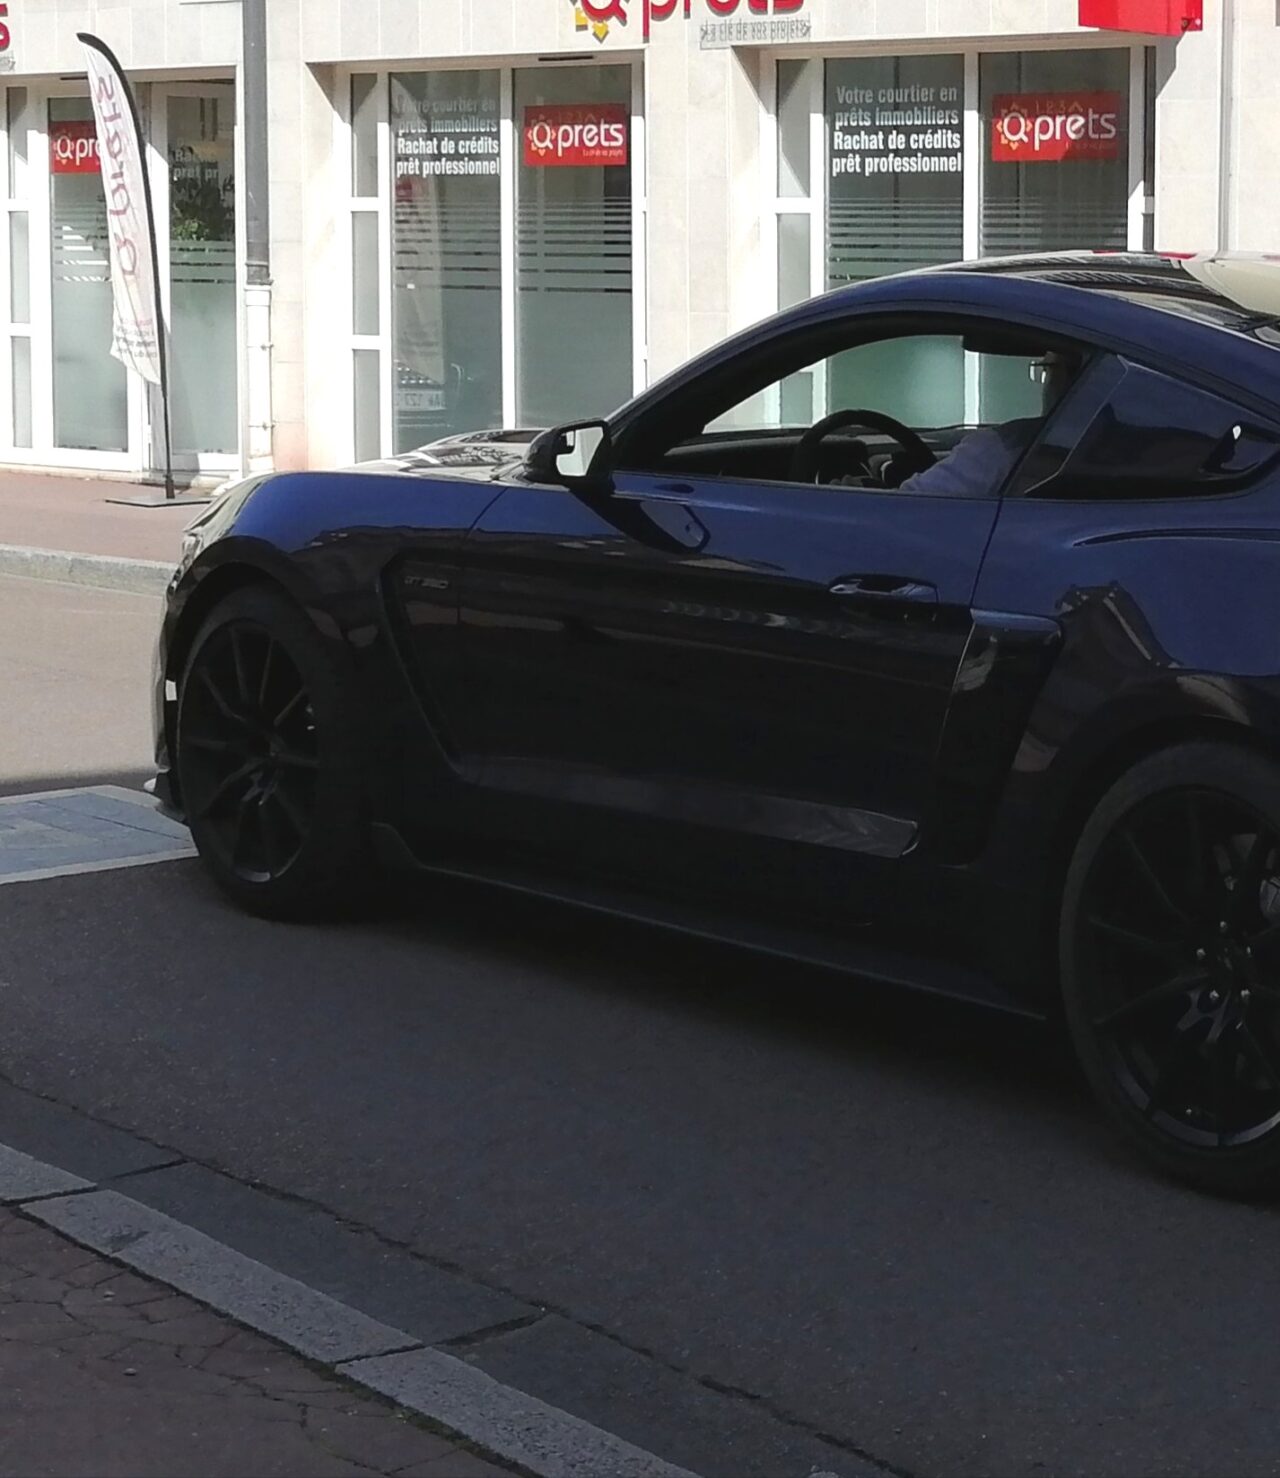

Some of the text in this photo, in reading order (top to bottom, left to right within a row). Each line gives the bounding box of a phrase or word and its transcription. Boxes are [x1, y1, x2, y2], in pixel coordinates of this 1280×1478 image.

[836, 83, 958, 104] Votre courtier en
[430, 114, 498, 133] immobiliers
[835, 104, 959, 130] prêts immobiliers
[397, 136, 499, 154] Rachat de crédits
[833, 128, 961, 150] Rachat de crédits
[396, 157, 500, 178] prêt professionnel
[832, 152, 962, 177] prêt professionnel
